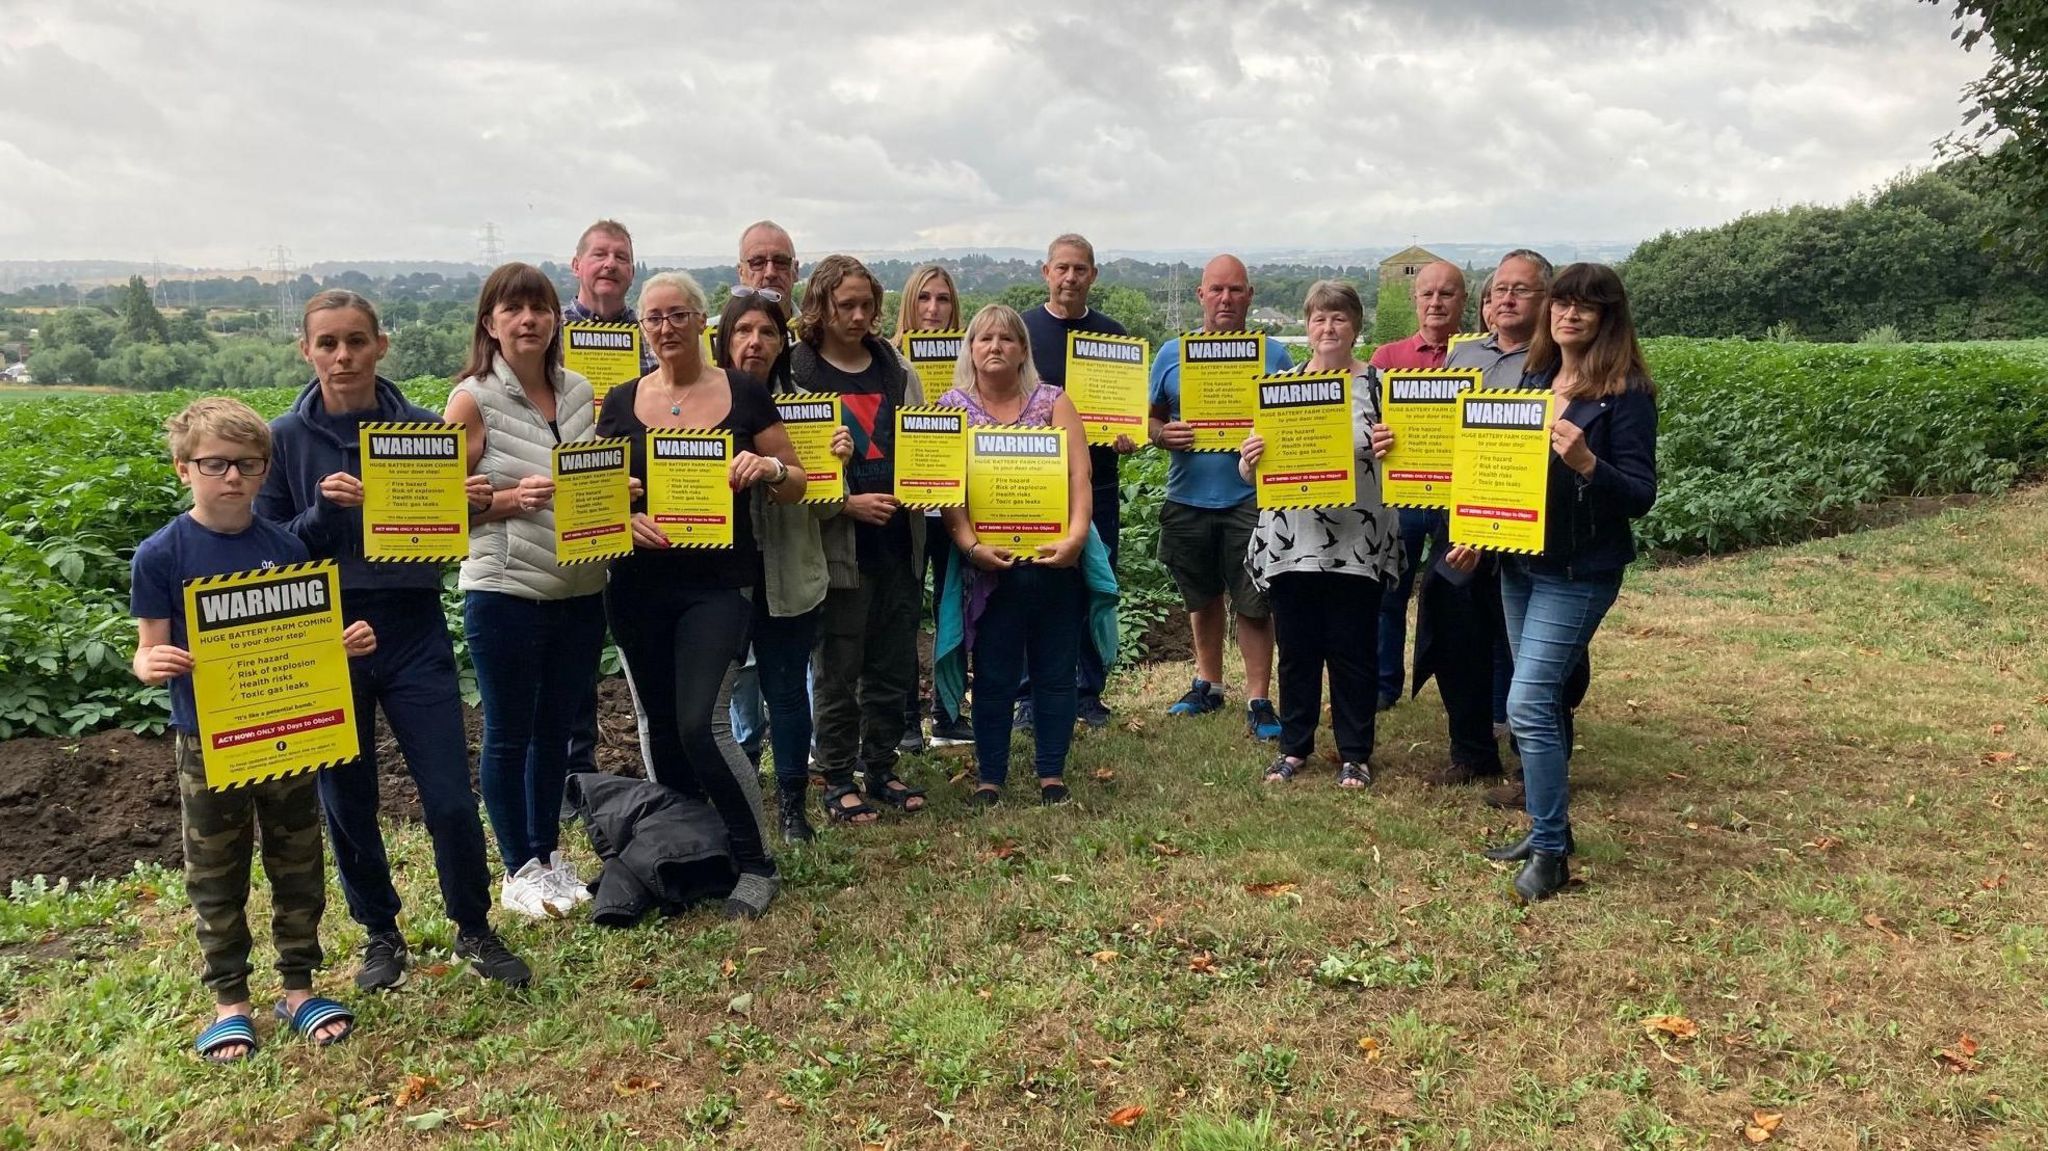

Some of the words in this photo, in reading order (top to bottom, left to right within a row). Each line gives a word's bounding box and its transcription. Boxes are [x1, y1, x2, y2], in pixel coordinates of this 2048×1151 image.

[573, 332, 630, 347] WARNING
[912, 340, 960, 358] WARNI
[1076, 340, 1140, 360] WARNING
[1189, 341, 1256, 358] WARNING
[1263, 381, 1341, 404] WARNING
[1465, 402, 1543, 425] WARNING
[903, 416, 958, 430] WARNING
[372, 436, 454, 454] WARNING
[657, 440, 723, 456] WARNING
[978, 435, 1056, 453] WARNING
[561, 450, 621, 471] WARNING
[201, 579, 325, 623] WARNING
[200, 634, 225, 644] HUGE
[229, 627, 268, 639] BATTERY
[271, 623, 295, 632] FARM
[297, 617, 332, 628] COMING
[242, 639, 261, 648] your
[263, 634, 283, 643] door
[286, 630, 306, 640] step!
[237, 658, 254, 667] Fire
[258, 652, 288, 664] hazard
[238, 668, 258, 678] Risk
[260, 666, 269, 674] of
[272, 658, 315, 673] explosion
[239, 677, 269, 689] Health
[272, 673, 292, 683] risks
[241, 689, 264, 699] Toxic
[267, 686, 283, 695] gas
[286, 681, 308, 691] leaks
[218, 735, 233, 743] ACT
[256, 727, 274, 736] ONLY
[286, 721, 302, 730] Days
[312, 715, 335, 725] Object
